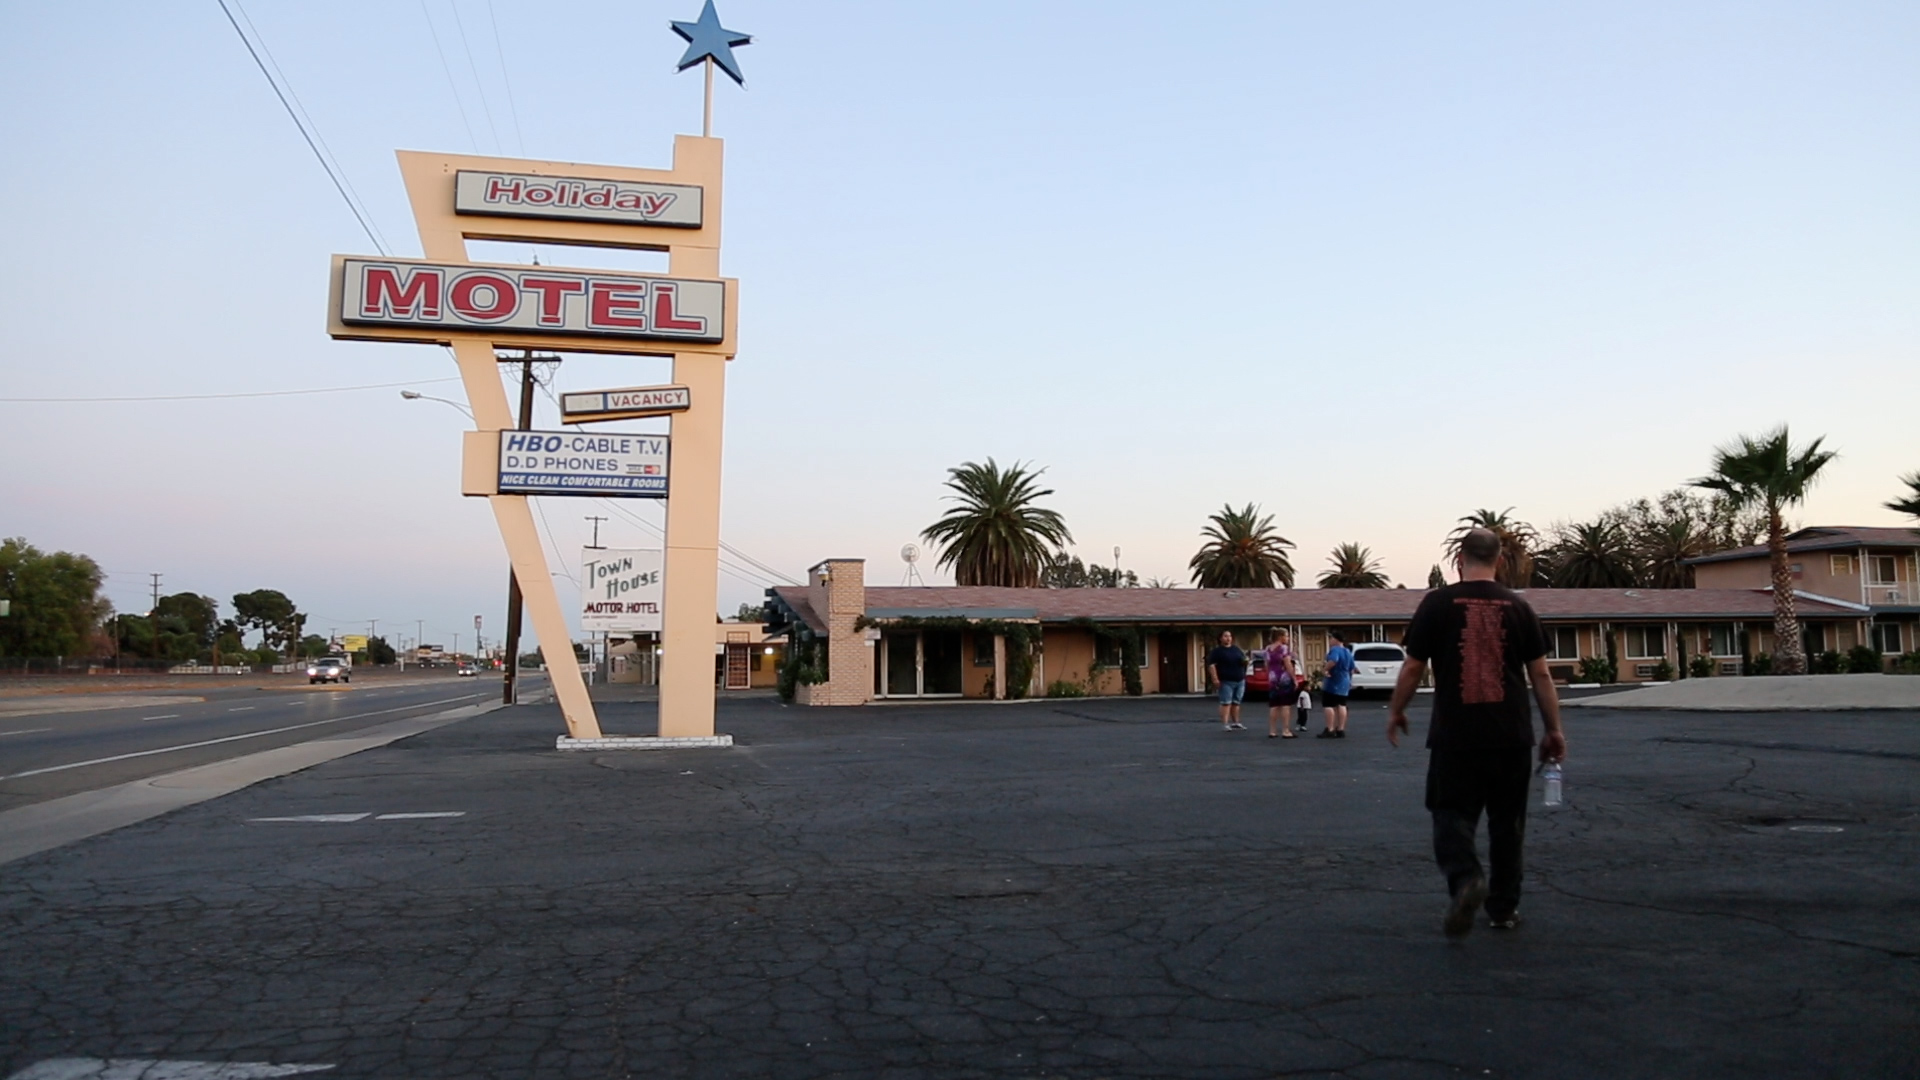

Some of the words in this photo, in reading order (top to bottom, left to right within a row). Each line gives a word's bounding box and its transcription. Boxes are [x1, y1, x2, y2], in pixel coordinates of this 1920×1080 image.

[485, 178, 676, 215] Holiday
[362, 266, 706, 334] MOTEL
[611, 392, 684, 407] VACANCY
[636, 440, 663, 455] T.V.
[544, 457, 619, 471] PHONES
[501, 475, 526, 485] NICE
[527, 476, 560, 485] CLEAN
[561, 477, 631, 488] COMFORTABLE
[631, 479, 667, 489] ROOMS
[583, 602, 624, 614] MOTOR
[626, 602, 660, 614] HOTEL
